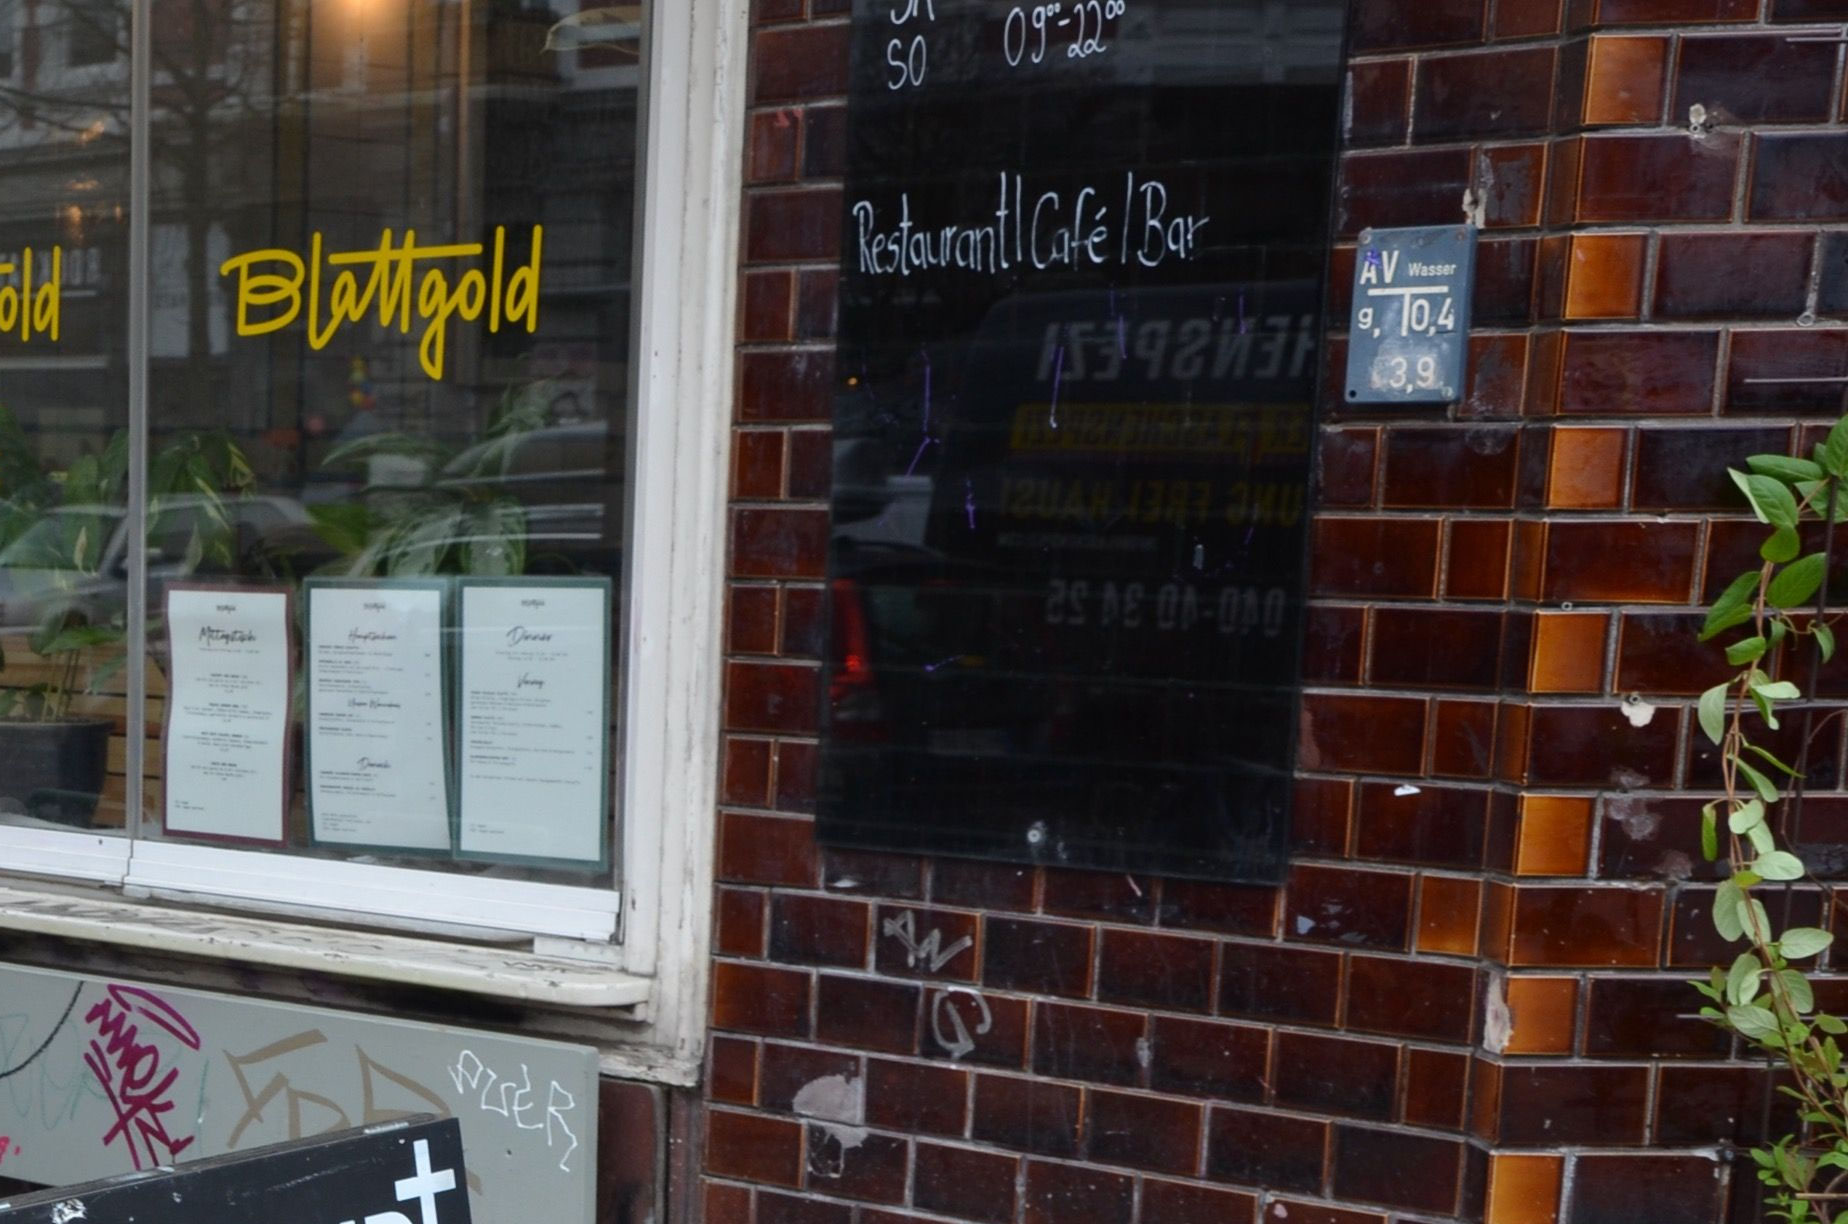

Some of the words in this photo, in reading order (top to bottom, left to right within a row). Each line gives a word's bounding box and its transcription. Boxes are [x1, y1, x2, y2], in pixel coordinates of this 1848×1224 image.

[886, 34, 927, 90] SO
[852, 171, 1009, 276] Restaurant
[1031, 186, 1108, 271] Café
[1137, 180, 1210, 268] Bar
[1359, 250, 1400, 285] AV
[1408, 261, 1457, 278] Wasser
[219, 224, 543, 381] Blattgold
[1389, 356, 1436, 394] 3,9
